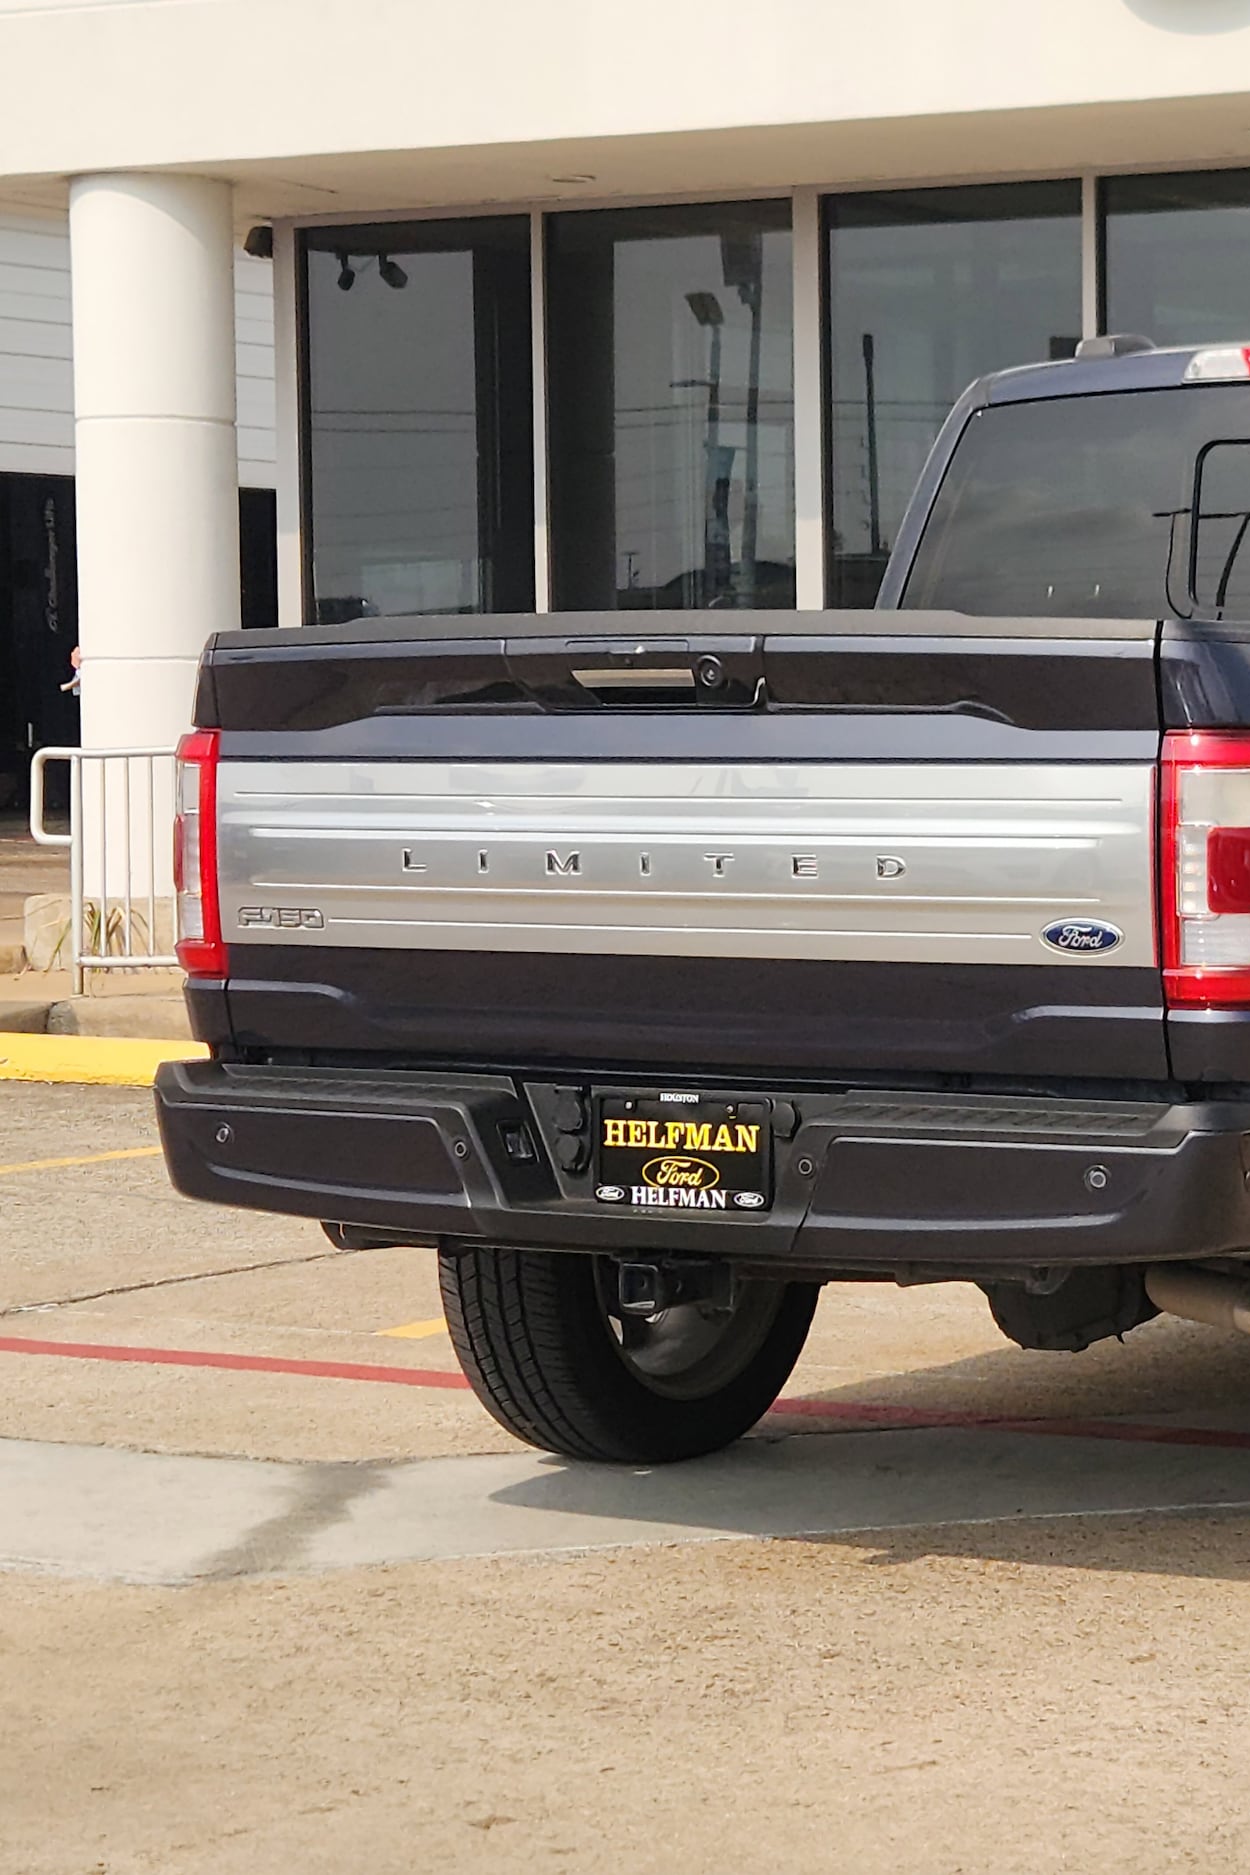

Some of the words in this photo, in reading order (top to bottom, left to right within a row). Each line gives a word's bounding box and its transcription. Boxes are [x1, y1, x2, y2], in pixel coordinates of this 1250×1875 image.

[401, 848, 907, 881] LIMITED
[1058, 924, 1103, 949] Ford
[603, 1118, 760, 1153] HELFMAN
[656, 1160, 704, 1187] Ford
[630, 1185, 727, 1209] HELFMAN
